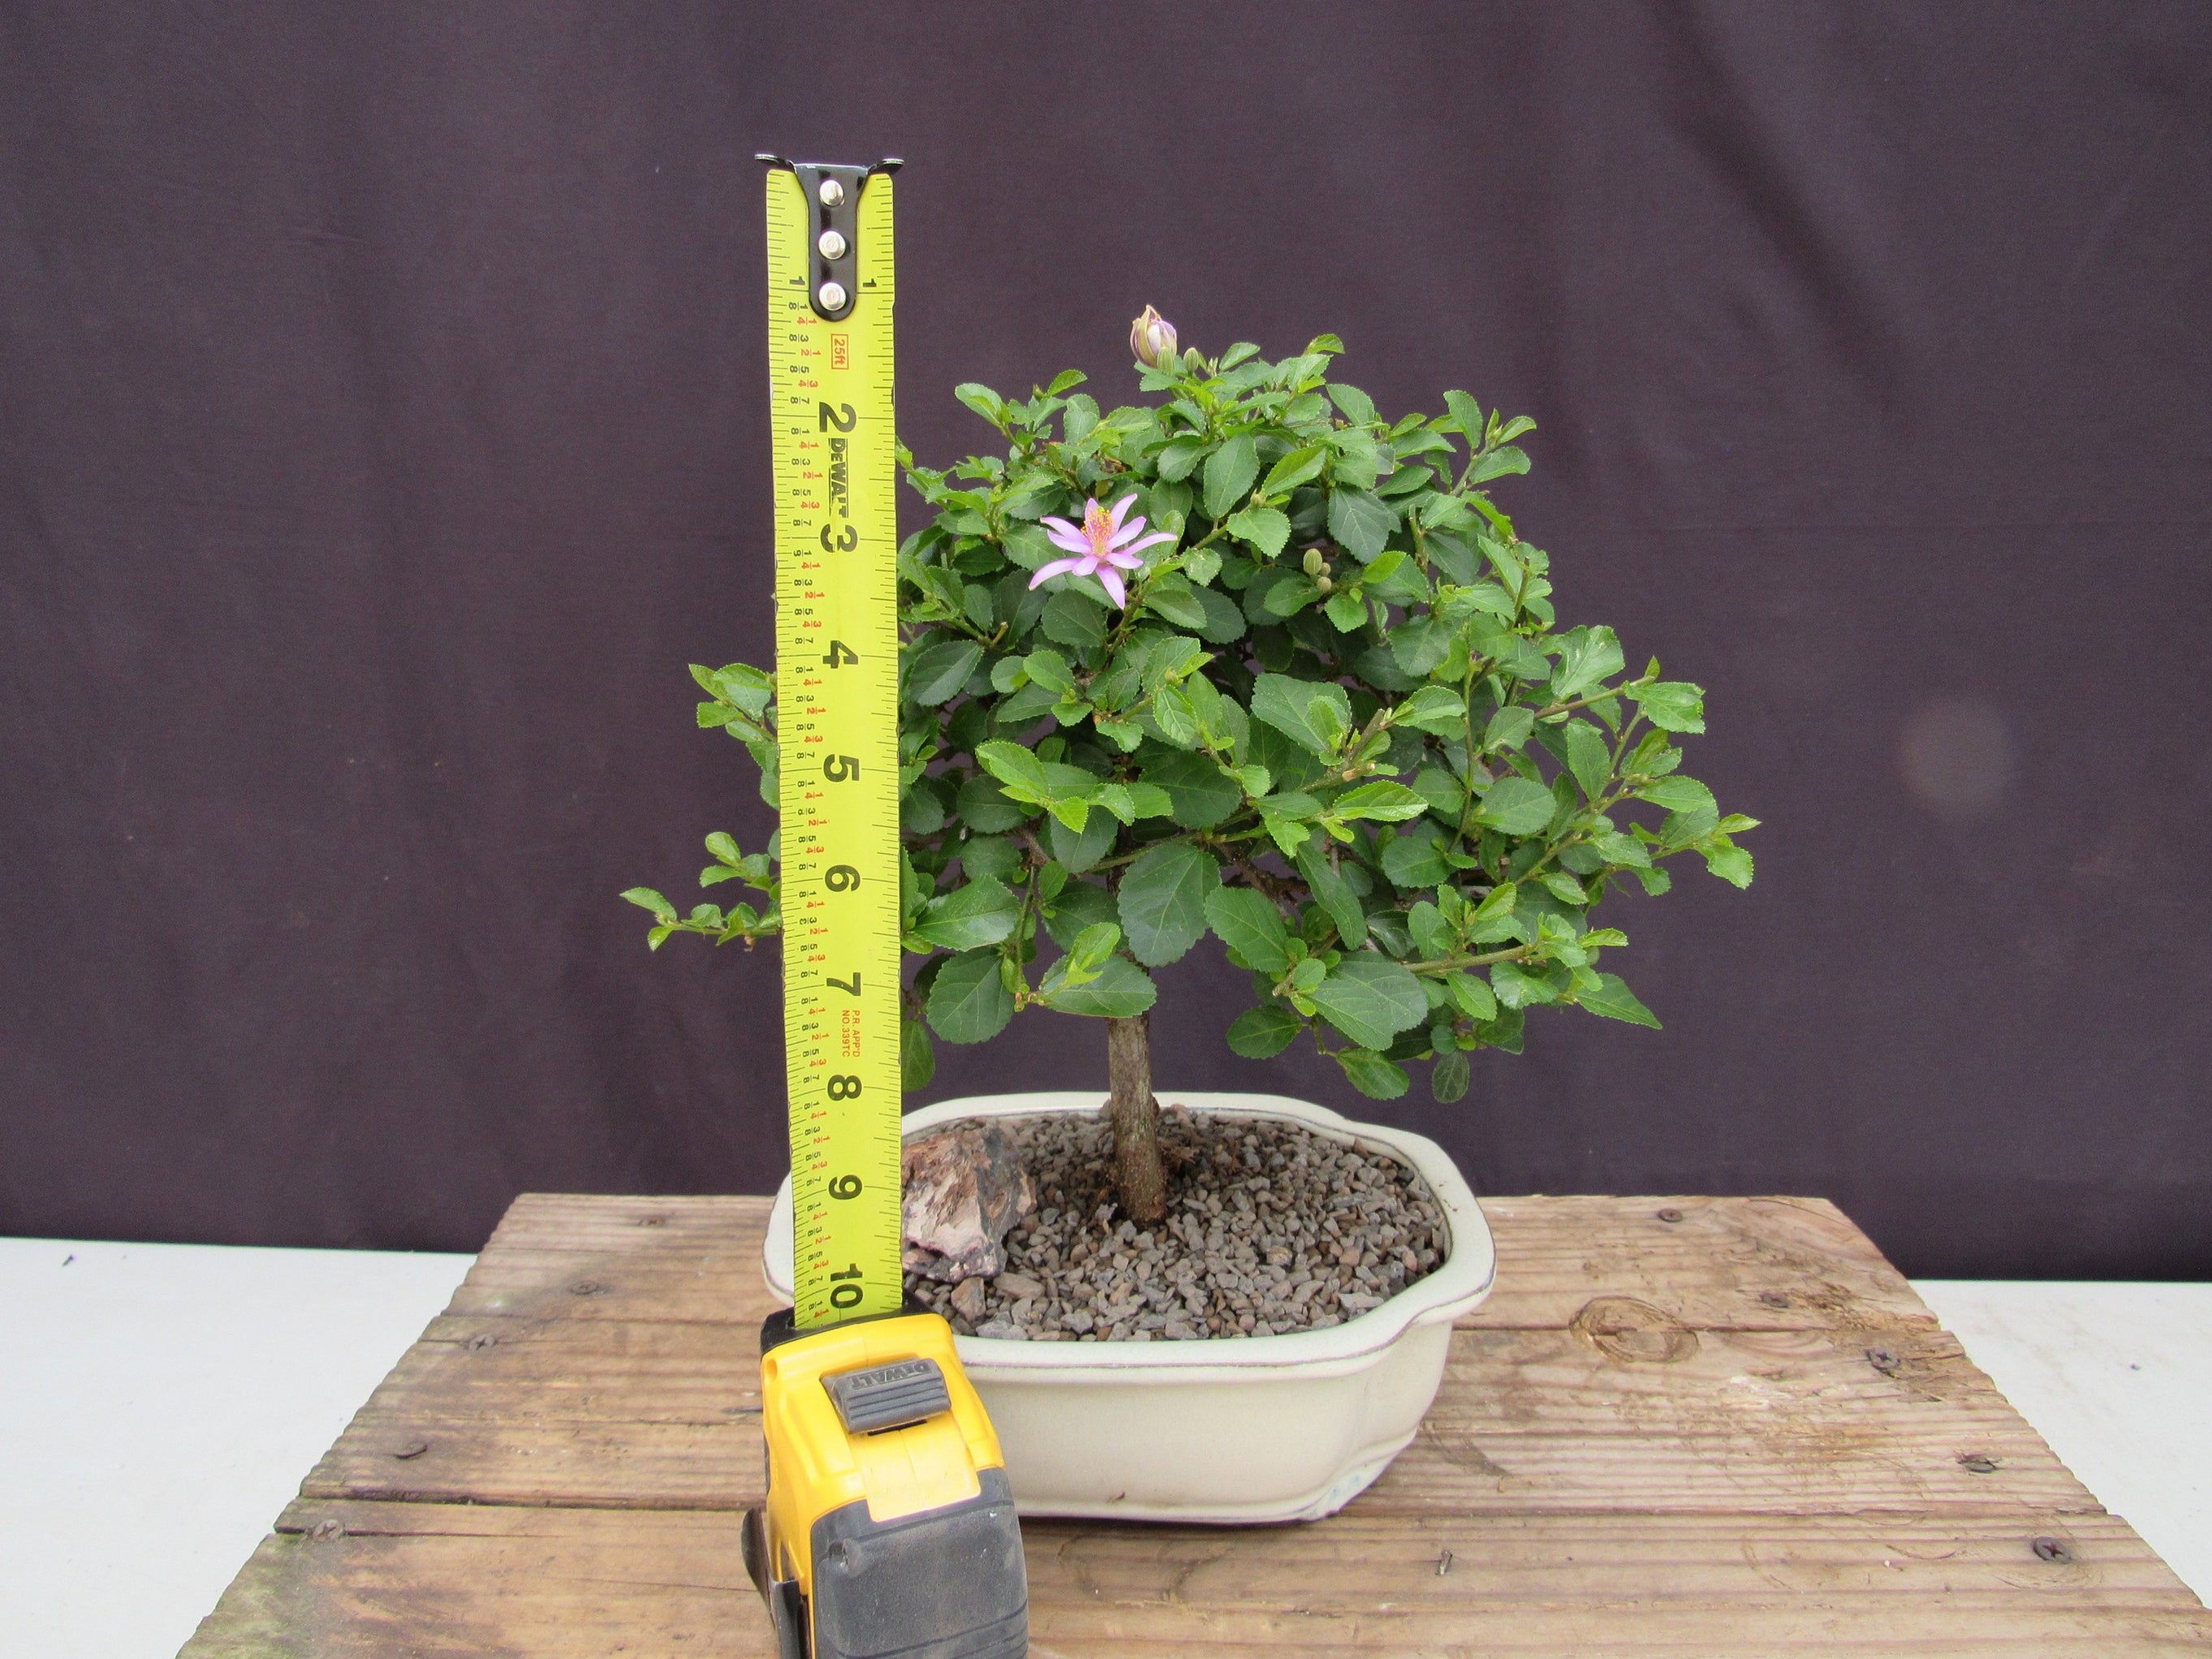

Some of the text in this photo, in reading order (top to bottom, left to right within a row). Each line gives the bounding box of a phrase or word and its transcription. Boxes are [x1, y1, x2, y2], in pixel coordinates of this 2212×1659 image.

[789, 276, 804, 286] 1
[862, 278, 877, 287] 1
[834, 338, 844, 365] 25ft
[819, 402, 856, 433] 2
[821, 524, 857, 553] 3
[823, 640, 858, 669] 4
[824, 754, 859, 782] 5
[825, 865, 860, 892] 6
[826, 972, 860, 997] 7
[828, 1075, 861, 1101] 8
[829, 1174, 862, 1200] 9
[830, 1263, 863, 1308] 10
